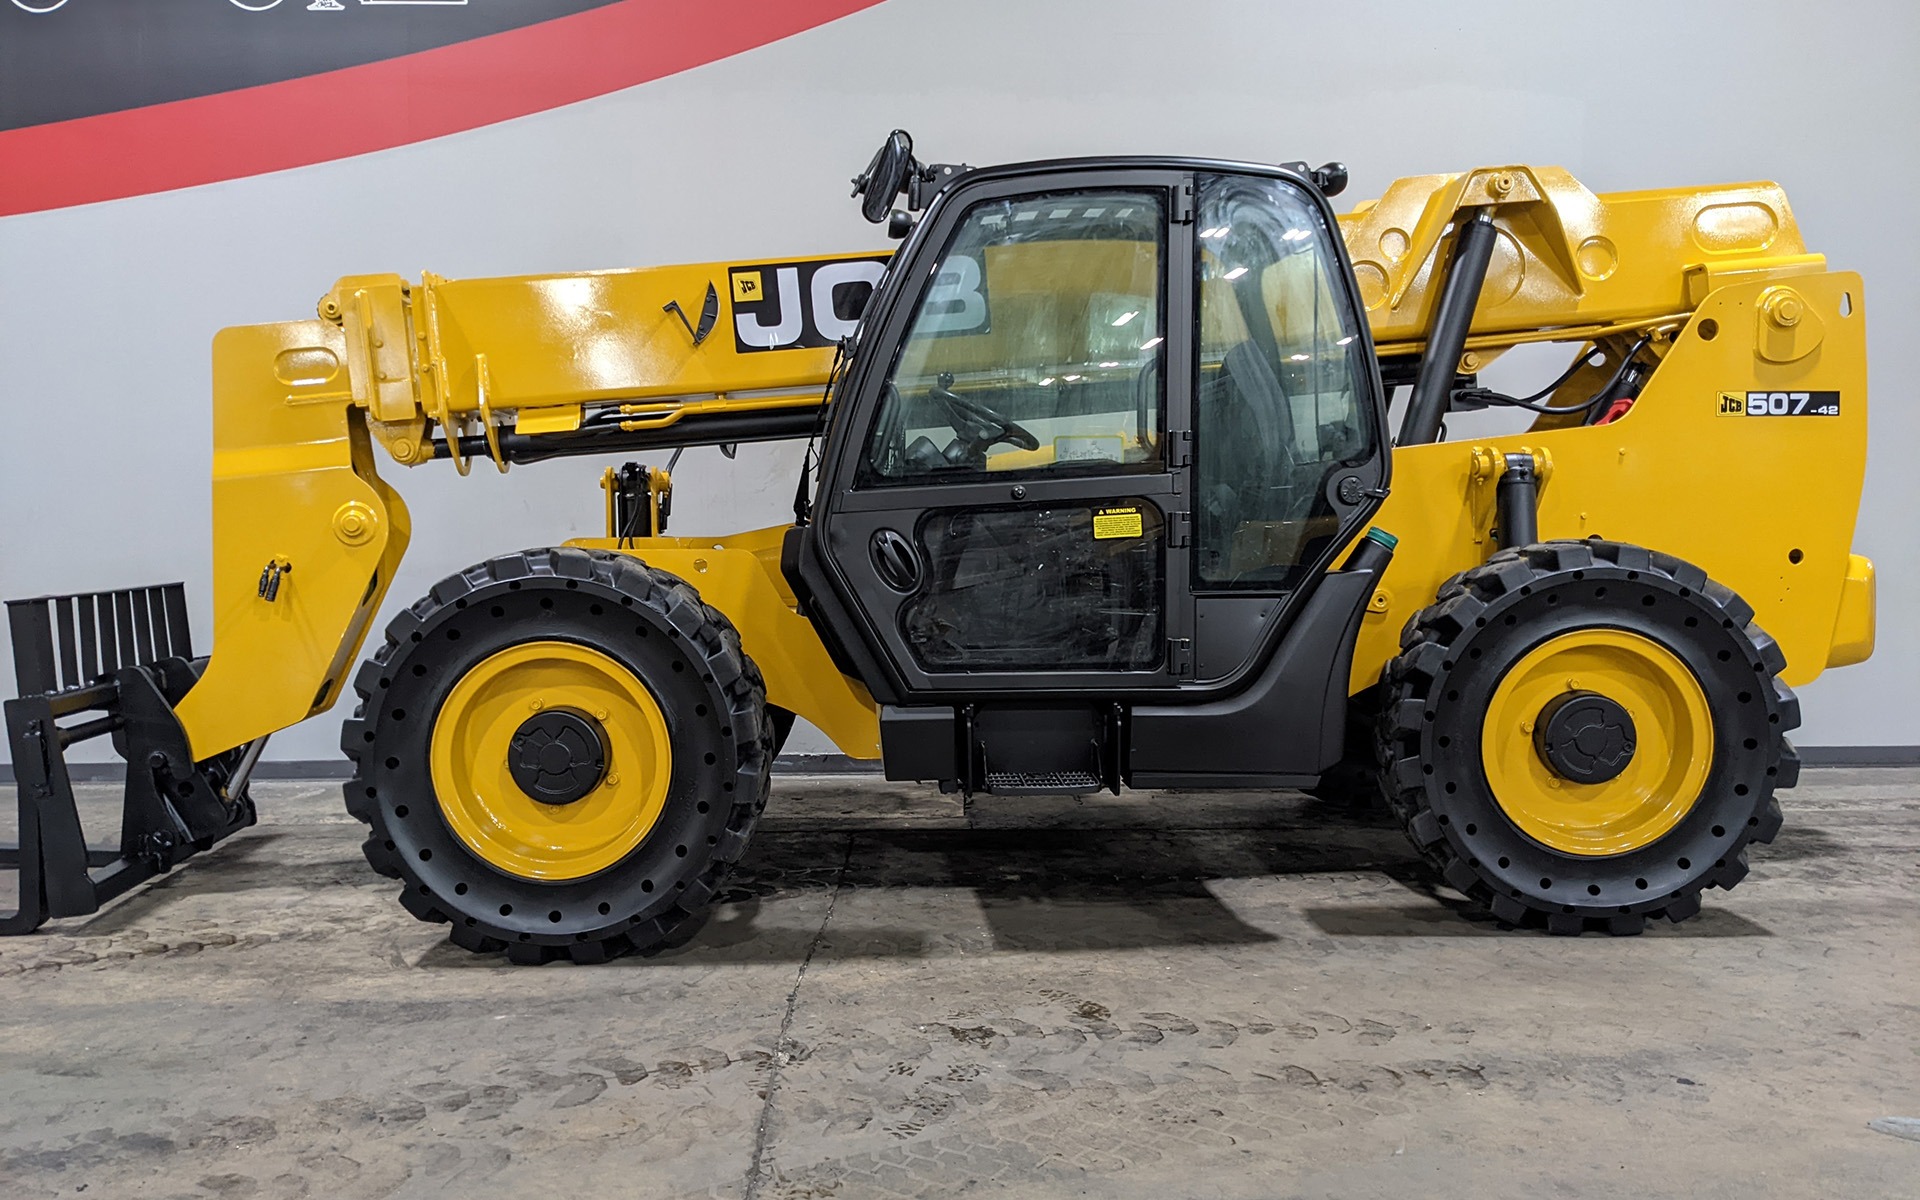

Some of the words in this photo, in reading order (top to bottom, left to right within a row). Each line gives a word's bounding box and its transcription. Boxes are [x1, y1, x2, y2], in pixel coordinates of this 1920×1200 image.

[740, 280, 756, 294] JCB
[736, 255, 987, 347] JCB
[1720, 395, 1742, 413] JCB
